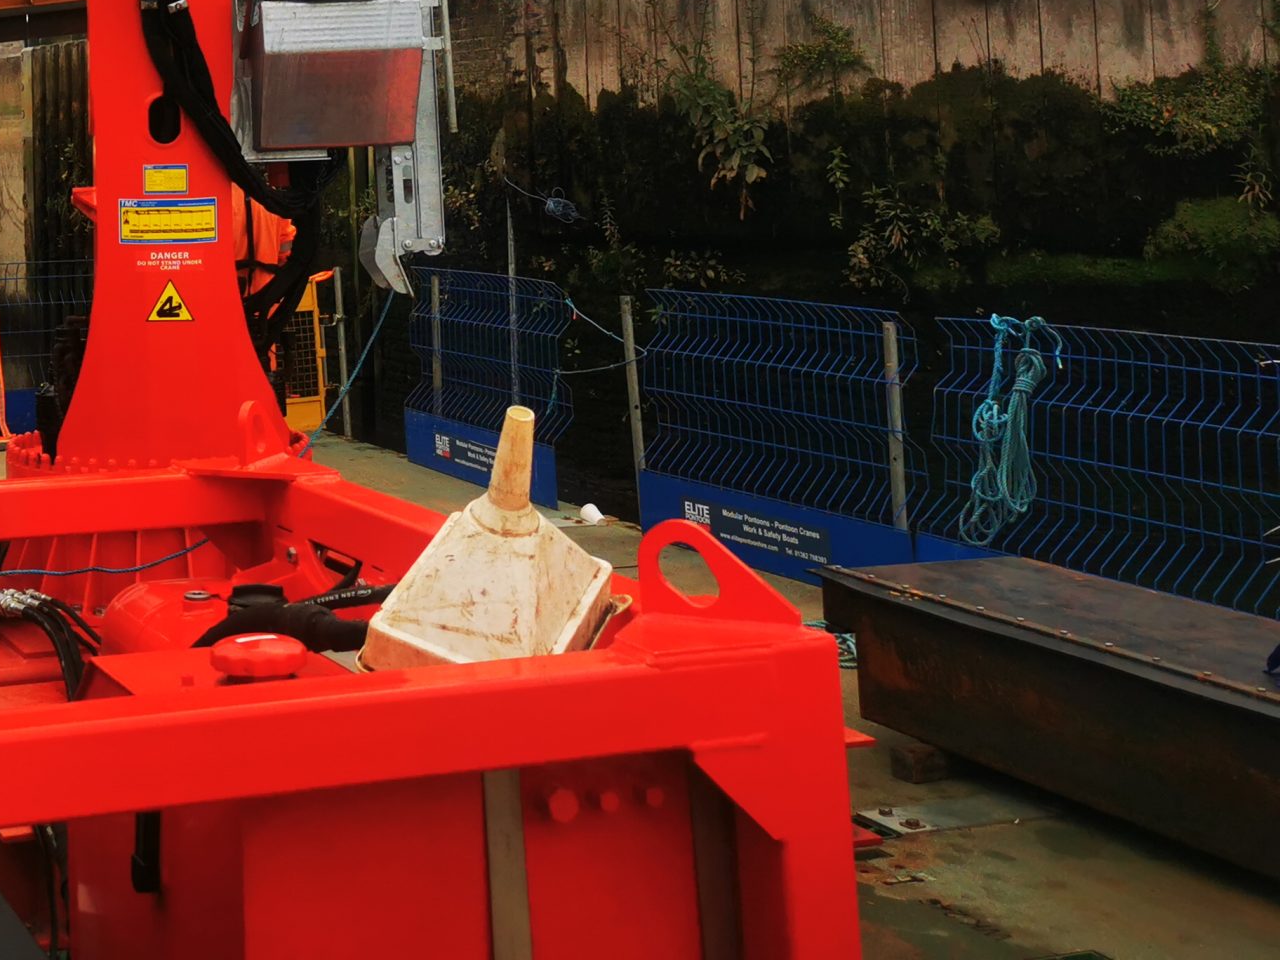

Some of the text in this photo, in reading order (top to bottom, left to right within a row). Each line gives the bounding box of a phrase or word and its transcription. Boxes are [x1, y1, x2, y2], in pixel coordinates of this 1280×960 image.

[121, 200, 138, 208] TMC
[150, 252, 190, 260] DANGER
[435, 433, 450, 448] ELITE
[684, 501, 710, 518] ELITE
[722, 508, 743, 521] Modular
[743, 514, 770, 528] Pontoons
[774, 520, 799, 534] Pontoon
[799, 526, 820, 539] Cranes
[742, 523, 757, 534] Work
[763, 529, 781, 542] Safety
[782, 533, 799, 545] Boats
